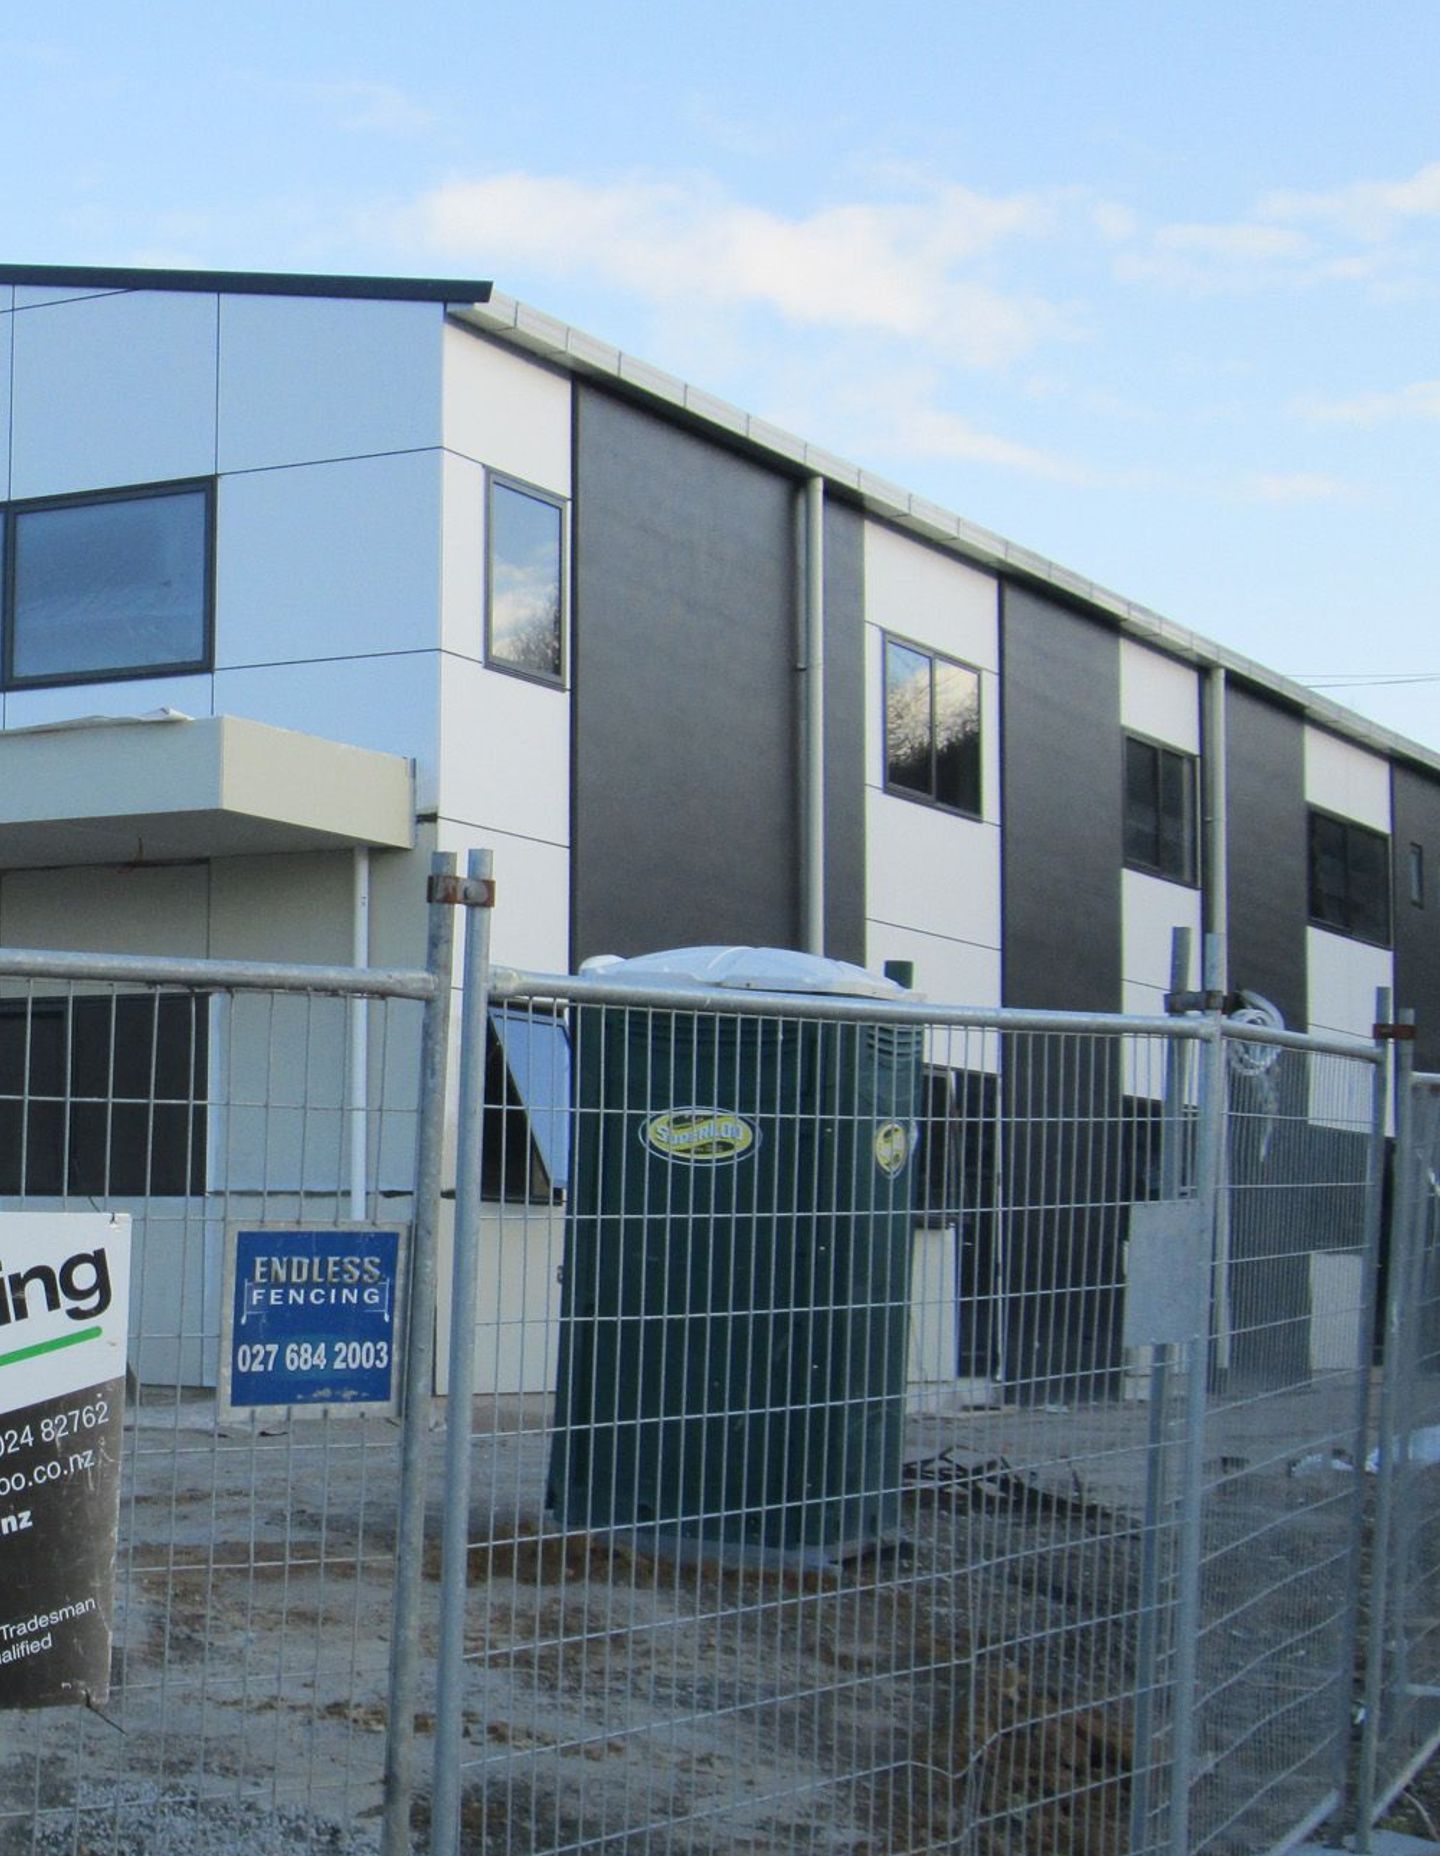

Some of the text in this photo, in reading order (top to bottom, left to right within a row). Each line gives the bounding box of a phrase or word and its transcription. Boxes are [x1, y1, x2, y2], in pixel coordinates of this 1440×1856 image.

[254, 1256, 381, 1284] ENDLESS
[252, 1288, 380, 1306] FENCING
[237, 1341, 389, 1373] 027 684 2003
[40, 1401, 110, 1442] 82762
